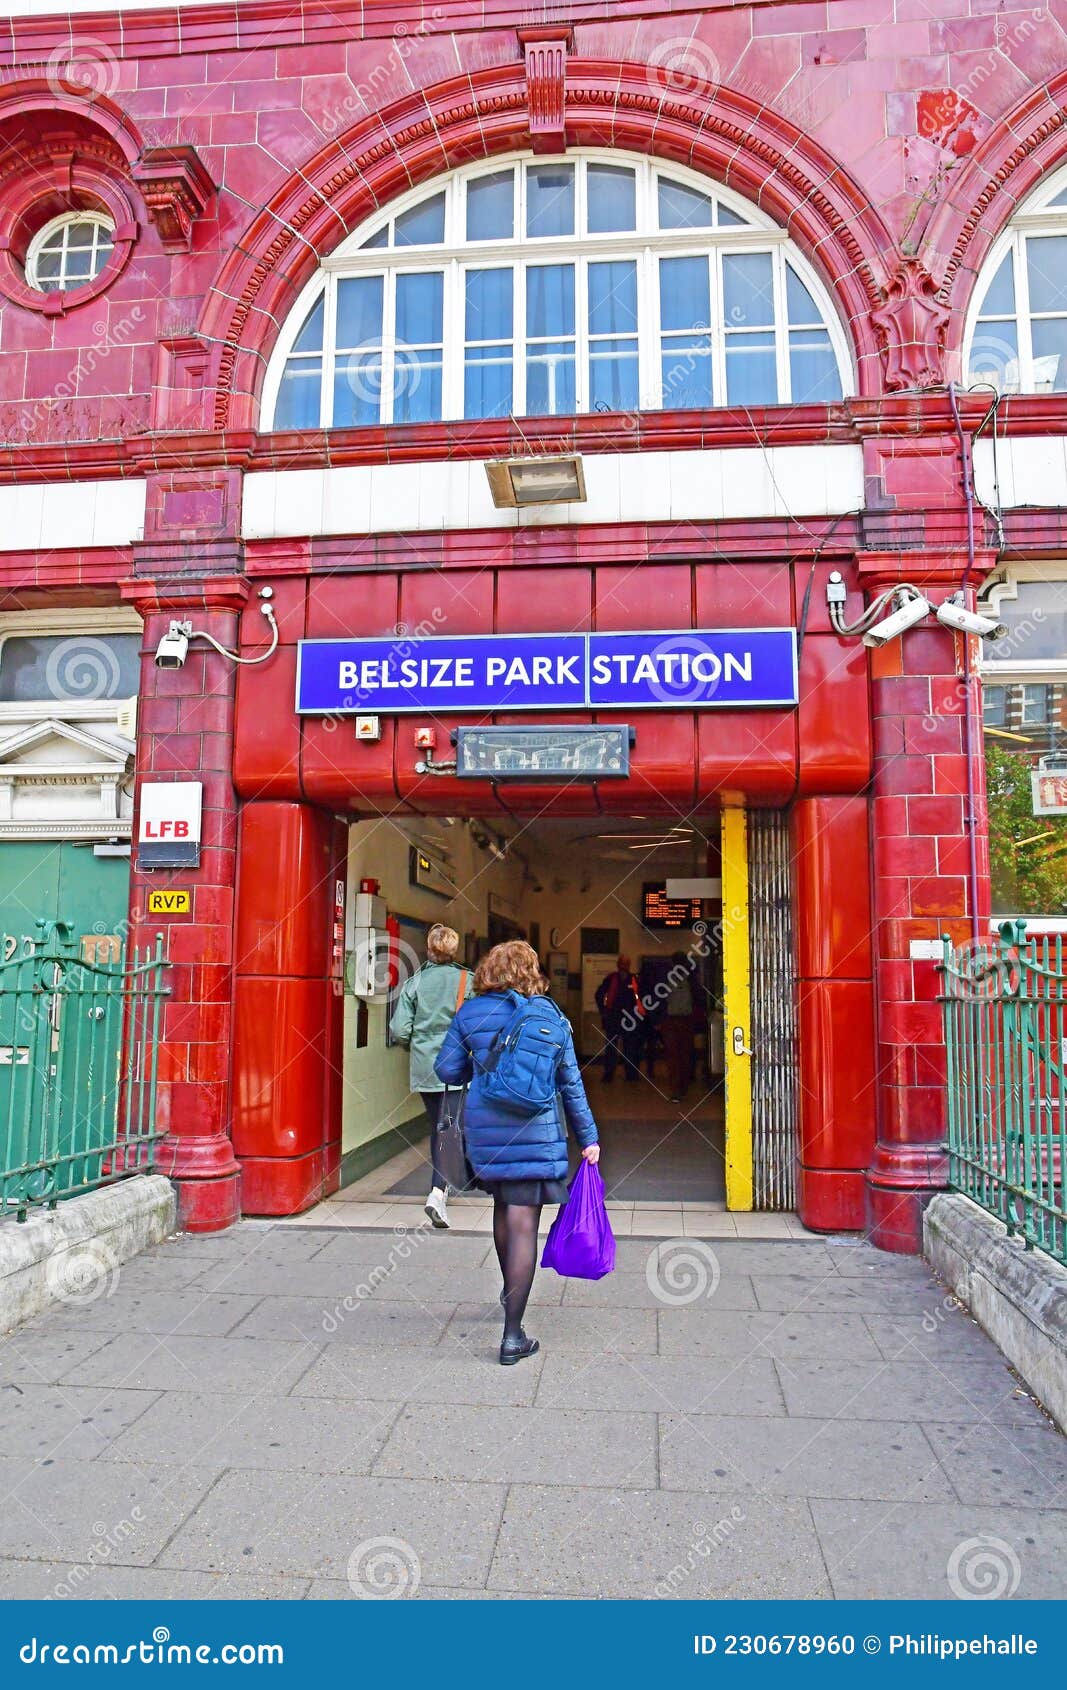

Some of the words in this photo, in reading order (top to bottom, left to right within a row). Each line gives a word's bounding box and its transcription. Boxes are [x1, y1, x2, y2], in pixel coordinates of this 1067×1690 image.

[338, 658, 475, 689] BELSIZE
[486, 655, 580, 686] PARK
[591, 652, 752, 684] STATION
[145, 820, 190, 838] LFB
[153, 894, 186, 909] RVP
